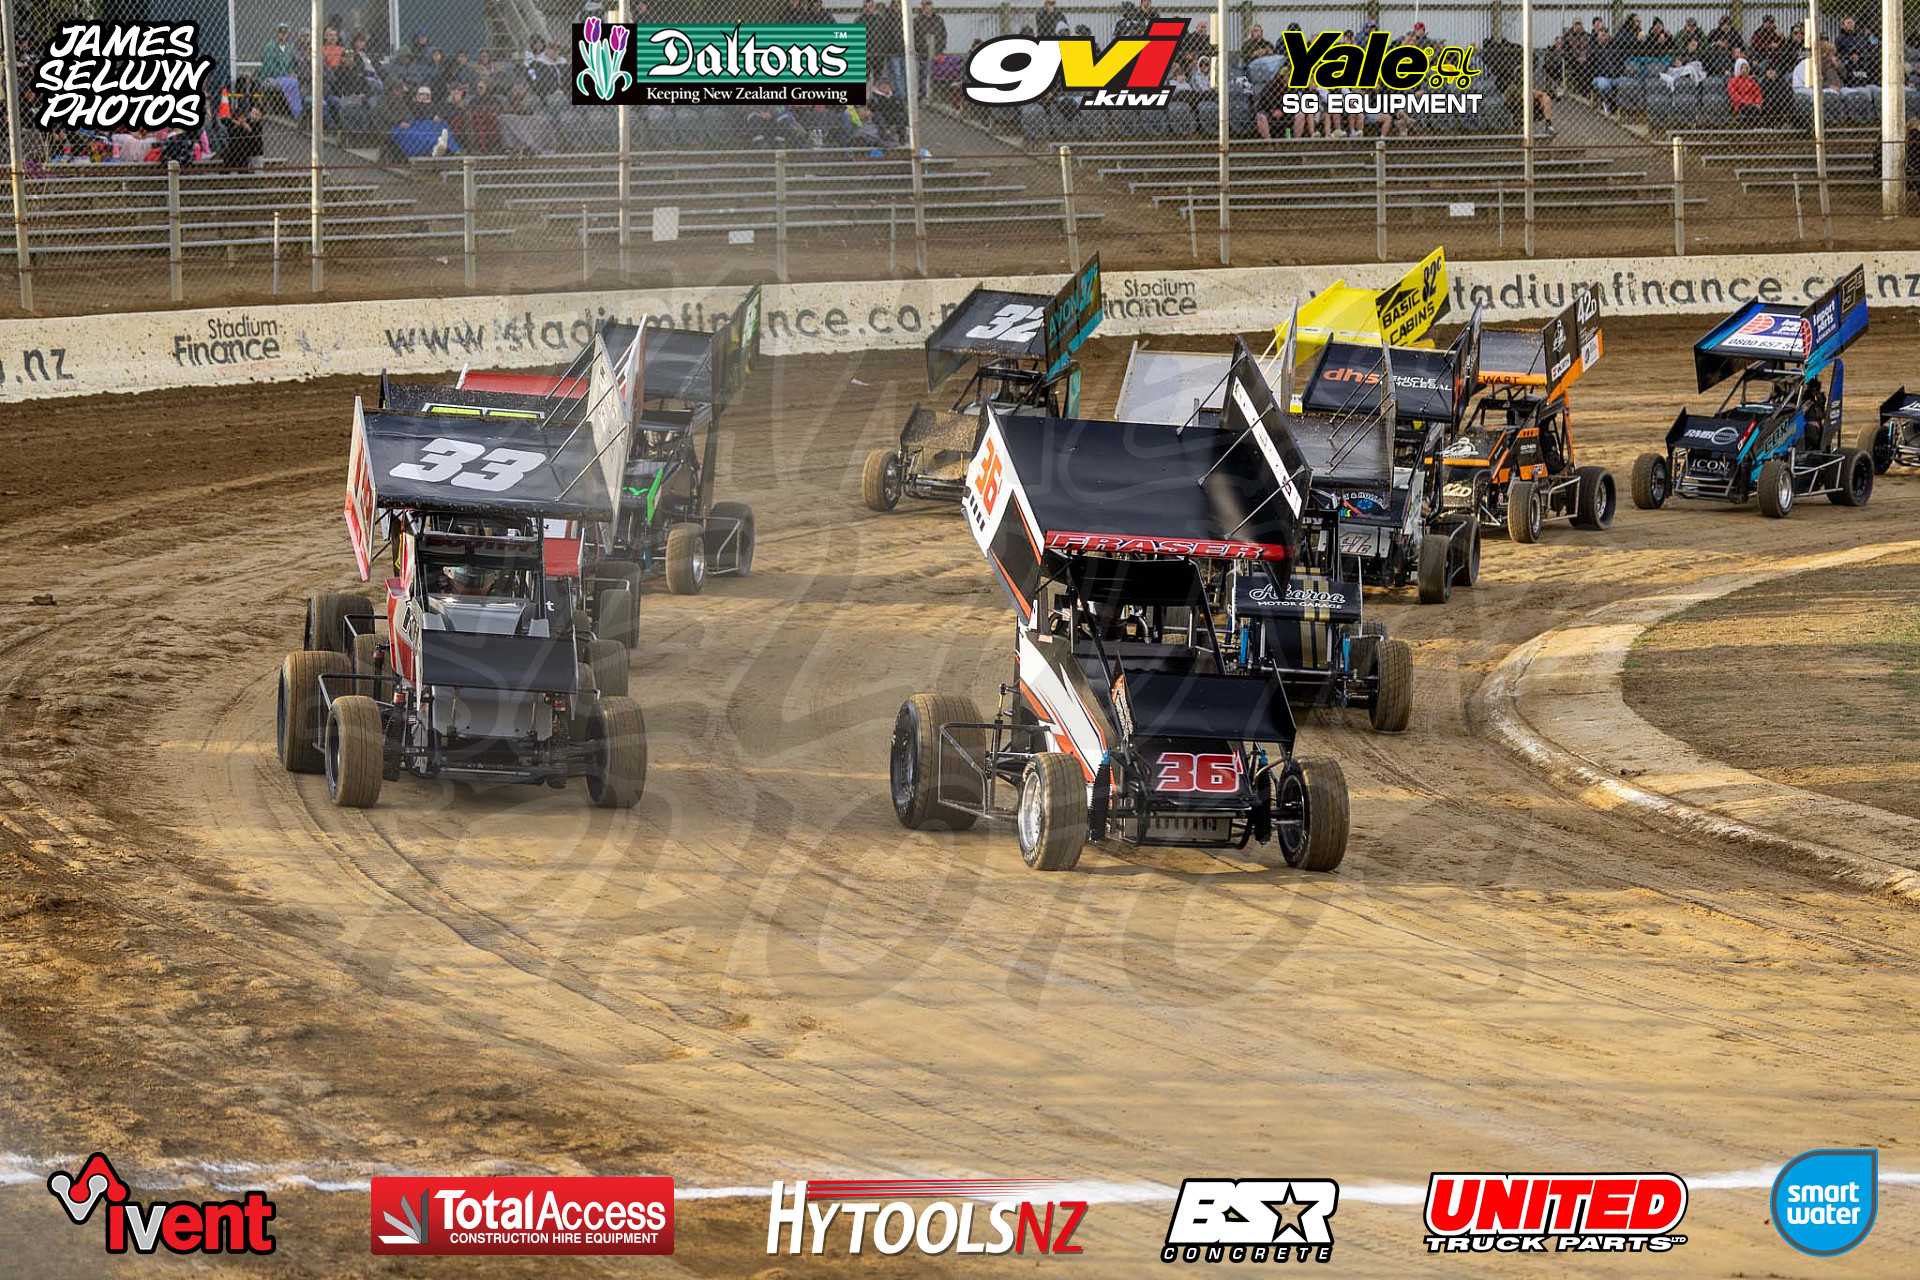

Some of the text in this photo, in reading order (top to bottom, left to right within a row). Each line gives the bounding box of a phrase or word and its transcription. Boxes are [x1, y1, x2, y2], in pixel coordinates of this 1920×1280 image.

[1124, 278, 1196, 298] Stadium
[1101, 293, 1199, 321] inance
[1382, 291, 1420, 330] BASIC
[207, 314, 278, 340] Stadium
[966, 303, 1047, 344] 32
[1389, 302, 1436, 346] CABINS
[173, 333, 281, 367] Finance
[0, 348, 75, 385] .nz
[1322, 367, 1381, 385] dhs
[1391, 375, 1437, 384] EHICLE
[1478, 374, 1520, 385] WART
[1391, 380, 1453, 391] HOLESAL
[388, 437, 548, 492] 33
[974, 436, 1003, 517] 36
[1691, 459, 1731, 471] ICON
[1050, 533, 1265, 560] FRASER
[1298, 601, 1342, 609] GARAGE
[1155, 752, 1242, 794] 36
